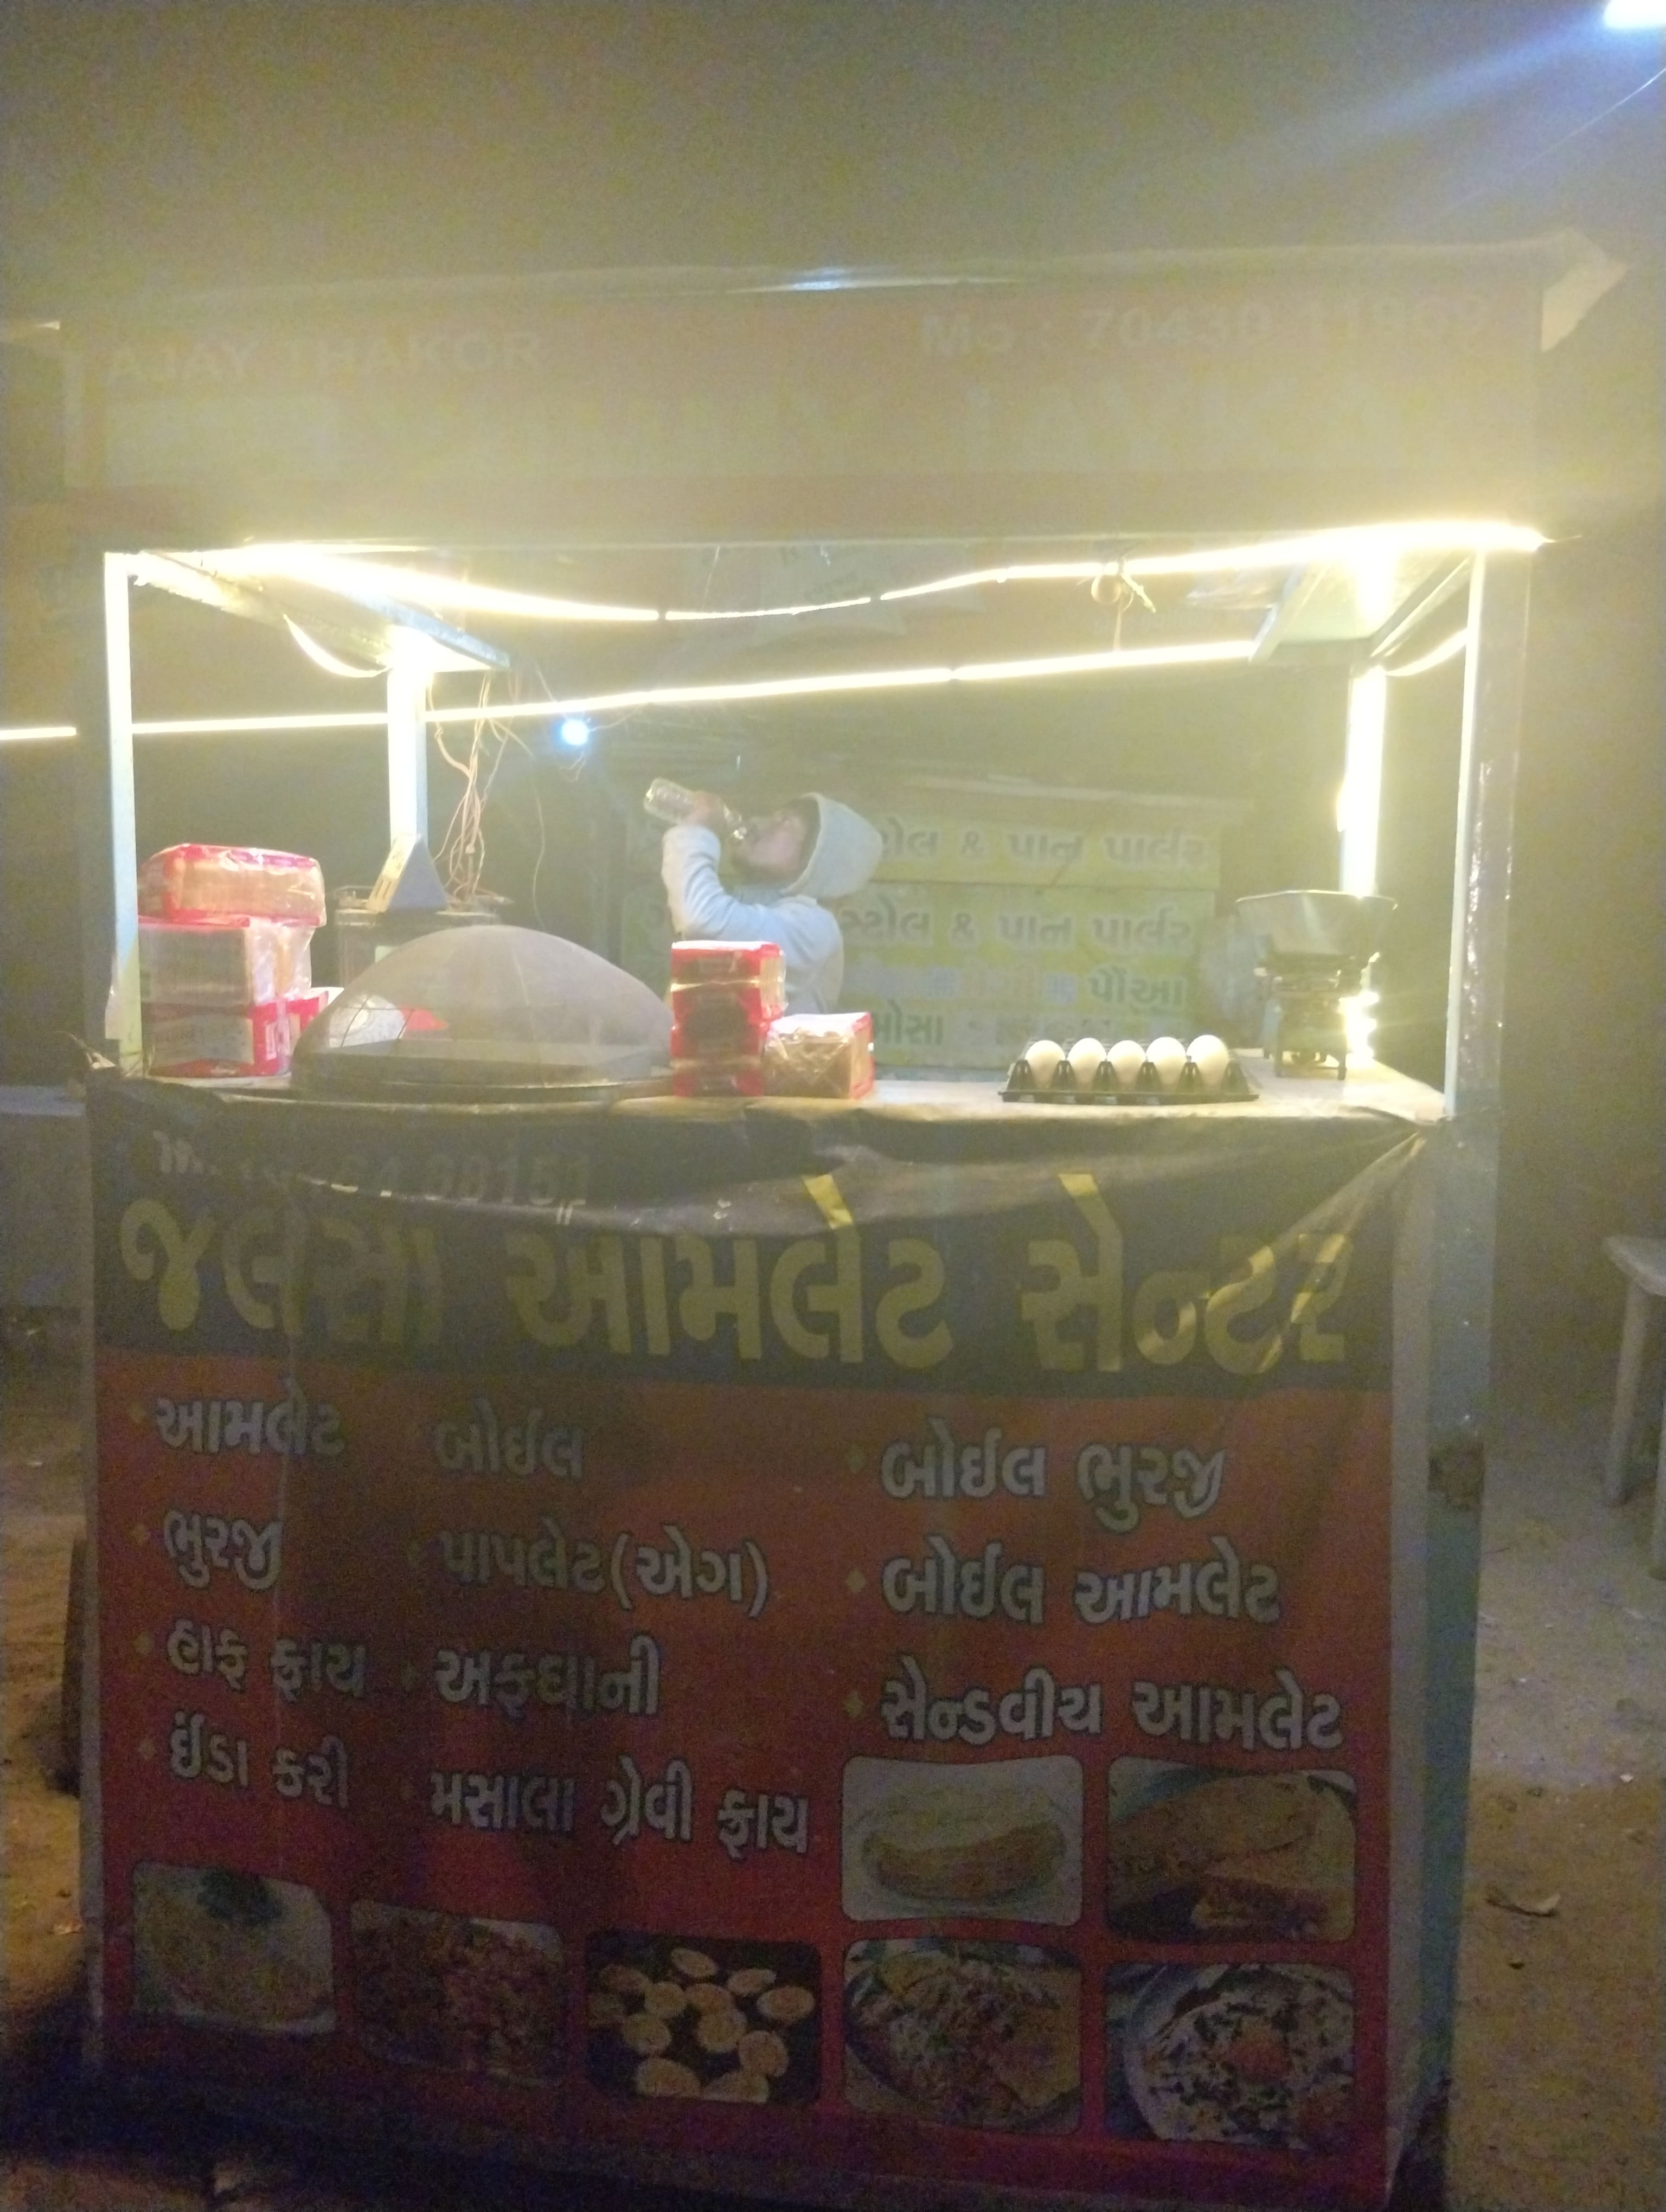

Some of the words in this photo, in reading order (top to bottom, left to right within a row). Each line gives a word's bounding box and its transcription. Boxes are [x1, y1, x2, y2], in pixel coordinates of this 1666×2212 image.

[106, 338, 260, 385] AJAY
[281, 330, 544, 379] THAKOR
[962, 829, 985, 855] &
[1008, 830, 1084, 860] પાન
[951, 912, 977, 940] &
[998, 914, 1072, 944] પાન
[1093, 906, 1192, 948] પાર્લર
[120, 1198, 443, 1346] જલસા
[504, 1174, 956, 1368] આમલેટ
[1021, 1173, 1355, 1375] સેન્ટર
[157, 1378, 345, 1456] આમલેટ
[433, 1399, 583, 1478] બોઈલ
[881, 1419, 1046, 1498] બોઈલ
[1078, 1444, 1225, 1532] ભુરજી
[164, 1509, 283, 1590] ભુરજી
[883, 1537, 1043, 1623] બોઈલ
[1075, 1536, 1280, 1623] આમલેટ
[167, 1619, 248, 1693] હાફ
[435, 1635, 659, 1718] અફઘાની
[1132, 1670, 1343, 1750] આમલેટ
[272, 1735, 349, 1809] કરી
[431, 1771, 575, 1831] મસાલા
[601, 1756, 693, 1846] ગ્રેવી
